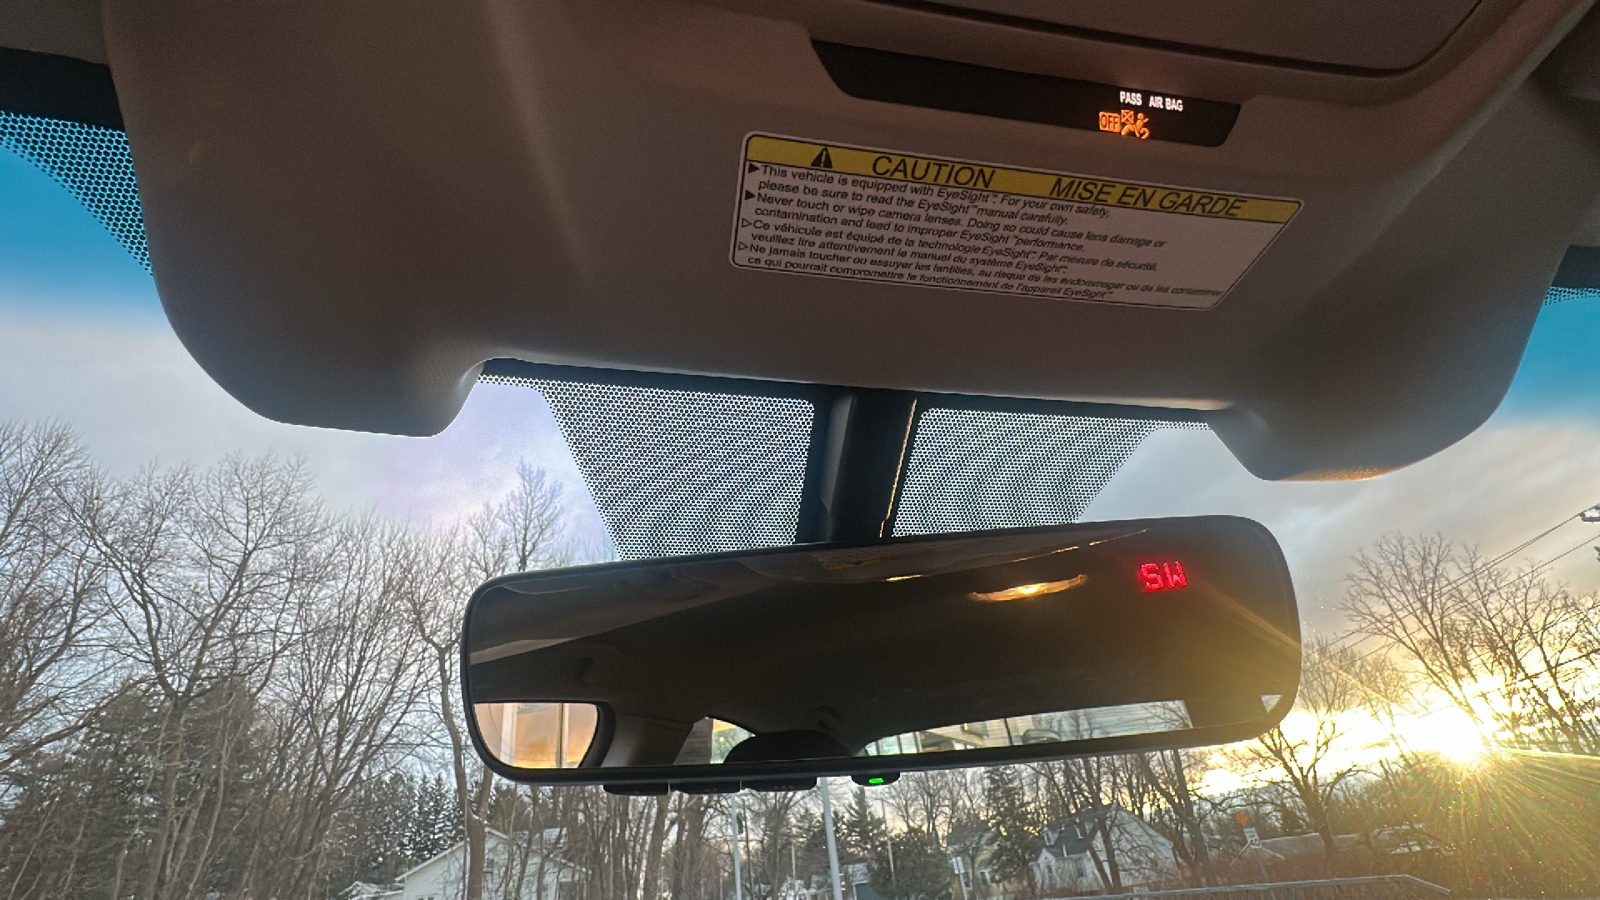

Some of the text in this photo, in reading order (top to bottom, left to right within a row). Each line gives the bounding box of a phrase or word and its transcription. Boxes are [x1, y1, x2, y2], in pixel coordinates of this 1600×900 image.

[1120, 91, 1184, 112] PASS AIR BAG
[1100, 113, 1120, 132] OFF
[872, 155, 996, 189] CAUTION
[758, 179, 799, 193] please
[803, 184, 818, 196] be
[821, 189, 848, 199] sure
[852, 191, 863, 201] to
[866, 195, 893, 205] read
[896, 197, 915, 207] the
[977, 207, 1019, 220] manual
[1020, 211, 1067, 227] carefully.
[761, 164, 787, 177] This
[791, 169, 834, 184] vehicle
[838, 175, 848, 186] is
[851, 178, 907, 194] equipped
[911, 184, 933, 196] with
[1000, 195, 1021, 206] For
[1021, 199, 1048, 210] your
[1050, 202, 1074, 211] own
[1075, 204, 1109, 219] safety,
[1050, 177, 1249, 217] MISE EN GARDE
[755, 207, 838, 225] contamination
[840, 217, 863, 228] and
[866, 219, 891, 231] lead
[894, 223, 905, 233] to
[907, 224, 958, 238] improper
[757, 192, 794, 206] Never
[796, 198, 829, 211] touch
[832, 203, 847, 213] or
[848, 204, 875, 217] wipe
[878, 209, 921, 222] camera
[967, 218, 1000, 232] Doing
[1002, 224, 1016, 233] so
[1018, 225, 1050, 236] could
[1051, 229, 1083, 240] cause
[1085, 231, 1108, 242] lens
[1109, 234, 1152, 248] damage
[1153, 240, 1167, 248] or
[751, 232, 795, 246] veuillez
[798, 236, 816, 247] lire
[818, 241, 895, 256] attentivement
[896, 247, 907, 258] le
[910, 250, 951, 262] manuel
[953, 254, 967, 264] du
[969, 256, 1013, 269] système
[753, 219, 770, 231] Ce
[773, 222, 822, 237] véhicule
[825, 230, 843, 240] est
[846, 230, 884, 245] équipé
[887, 235, 902, 246] de
[904, 237, 915, 248] la
[918, 238, 980, 254] technologie
[1039, 251, 1058, 261] Par
[1060, 255, 1099, 266] mesure
[1101, 258, 1115, 268] de
[747, 256, 761, 264] ce
[764, 258, 781, 268] qui
[784, 260, 827, 273] pourrait
[829, 266, 904, 280] compromettre
[906, 272, 917, 281] le
[919, 273, 999, 289] fonctionnement
[1000, 281, 1014, 290] de
[749, 243, 766, 254] Ne
[768, 245, 806, 259] jamais
[809, 250, 851, 263] toucher
[853, 256, 867, 265] ou
[869, 259, 911, 270] essuyer
[914, 260, 930, 271] les
[978, 269, 991, 278] au
[993, 270, 1026, 281] risque
[1027, 273, 1042, 282] de
[1043, 275, 1058, 284] les
[1060, 278, 1124, 291] endommager
[1126, 283, 1139, 291] ou
[1140, 284, 1154, 292] de
[1141, 561, 1187, 590] SW
